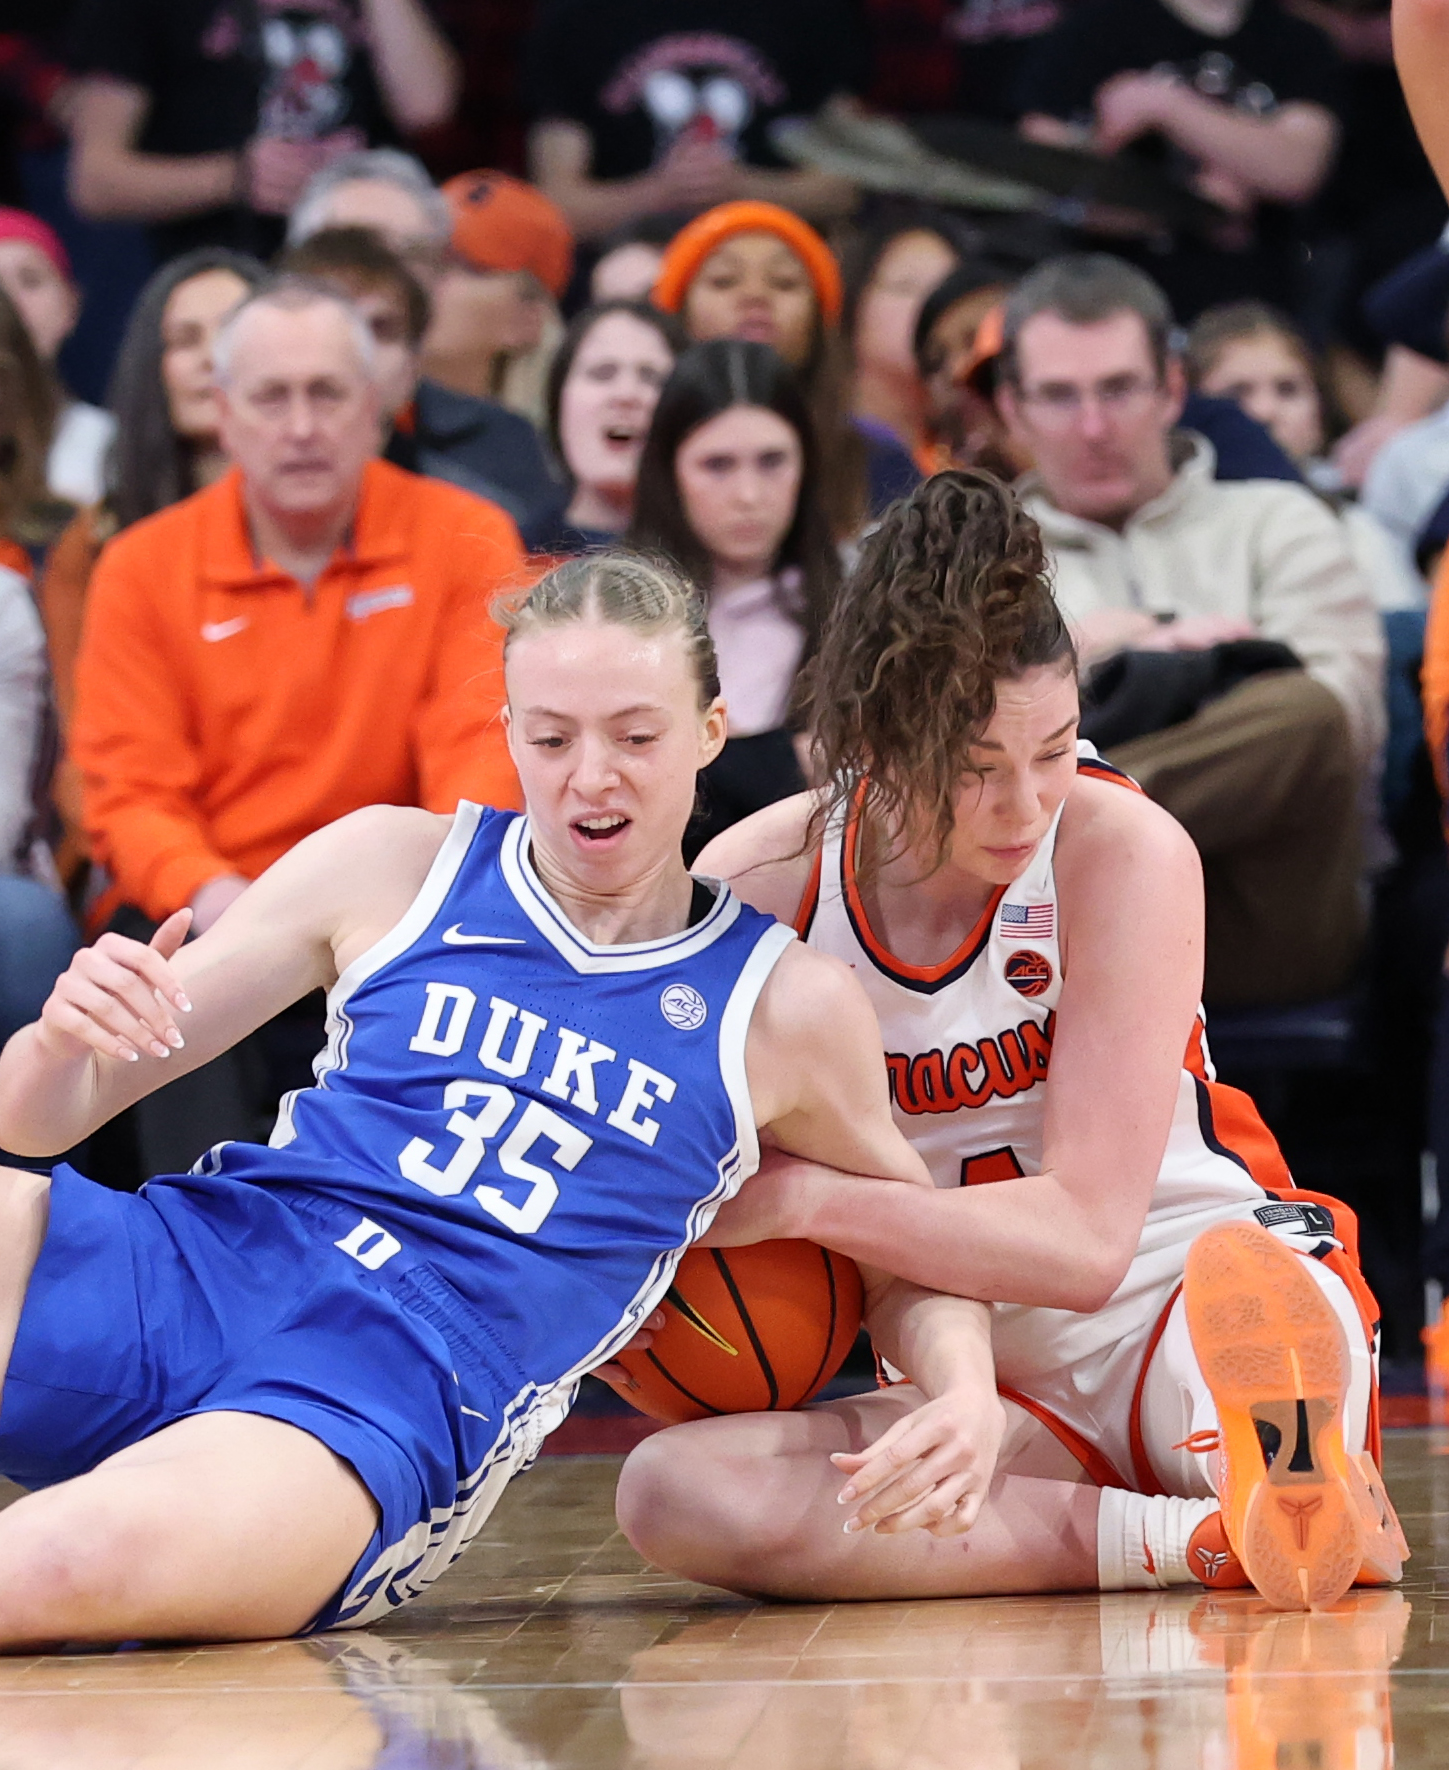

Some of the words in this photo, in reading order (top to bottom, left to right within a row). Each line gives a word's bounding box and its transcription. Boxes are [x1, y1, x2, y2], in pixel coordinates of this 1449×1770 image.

[1009, 964, 1049, 978] ACC
[666, 997, 703, 1018] ACC
[408, 981, 678, 1148] DUKE
[397, 1078, 594, 1235] 35
[333, 1215, 402, 1271] D
